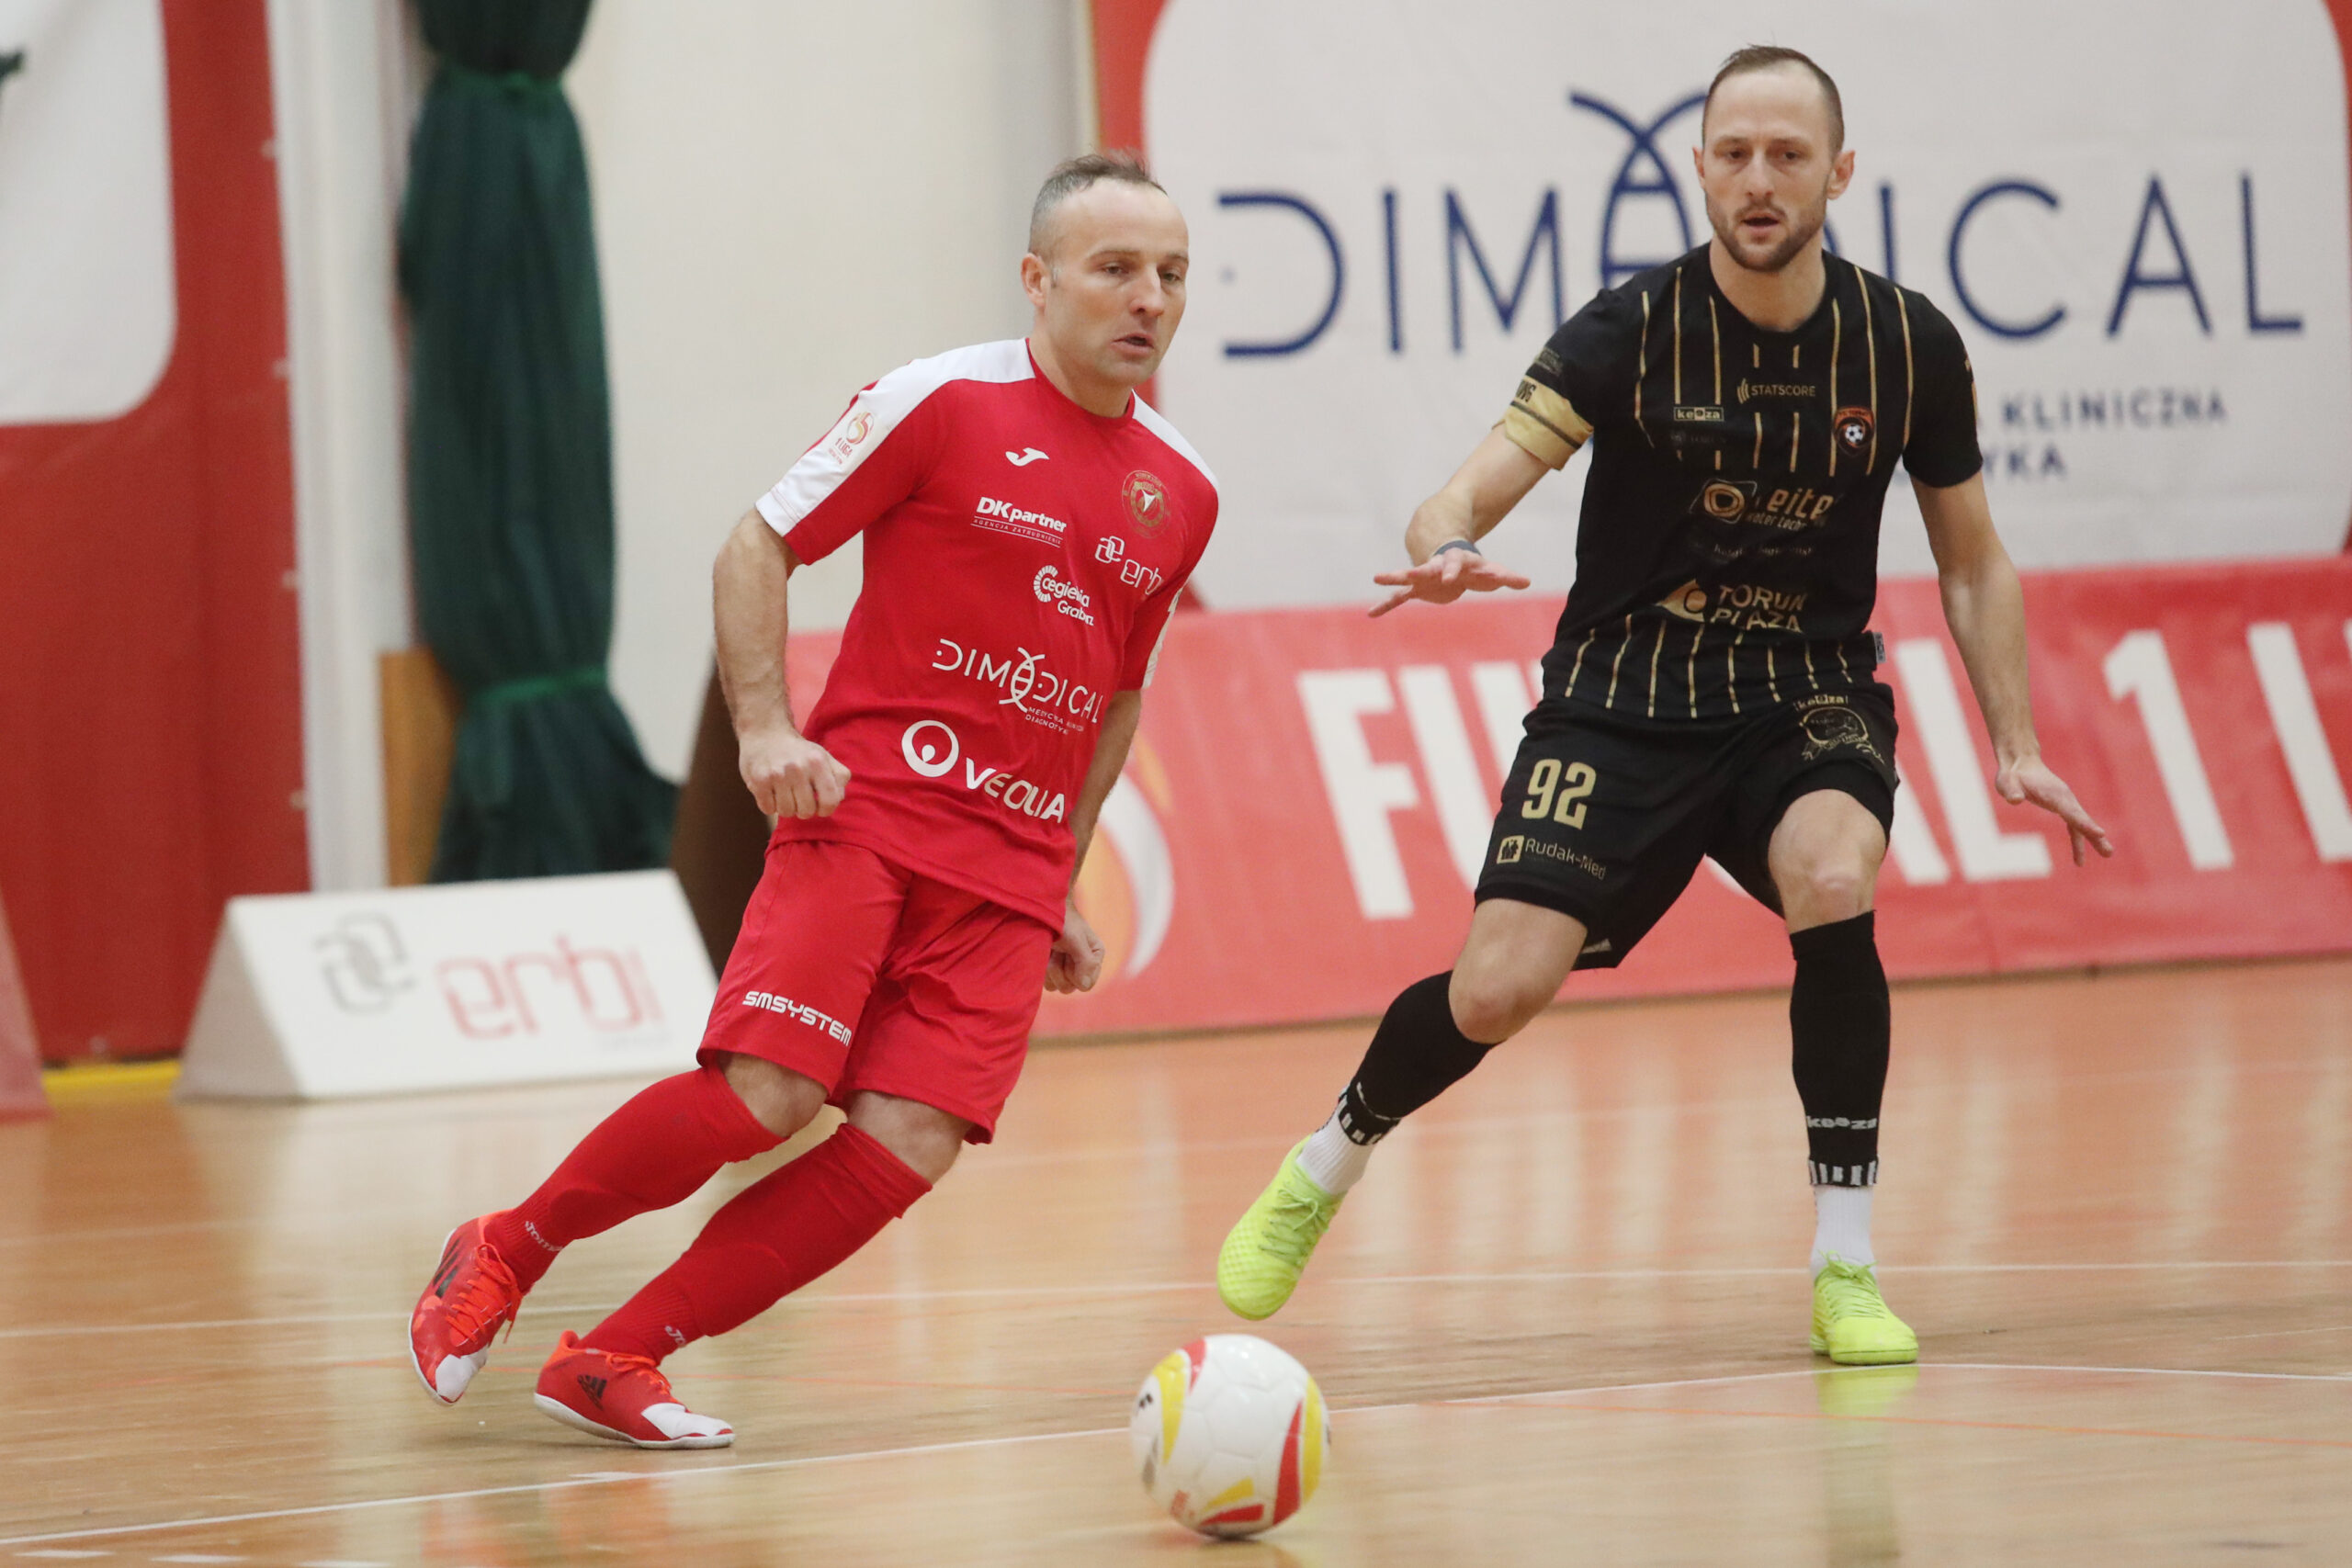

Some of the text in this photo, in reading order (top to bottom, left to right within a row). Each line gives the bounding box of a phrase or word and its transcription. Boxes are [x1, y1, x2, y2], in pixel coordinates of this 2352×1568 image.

[1750, 385, 1816, 397] STATSCORE
[973, 518, 1009, 530] AGENCJA
[2102, 628, 2234, 872] 1
[966, 757, 1066, 823] VEOLIA
[1521, 759, 1597, 830] 92
[1525, 838, 1607, 881] Rudak-Med
[742, 990, 853, 1046] SMSYSTEM
